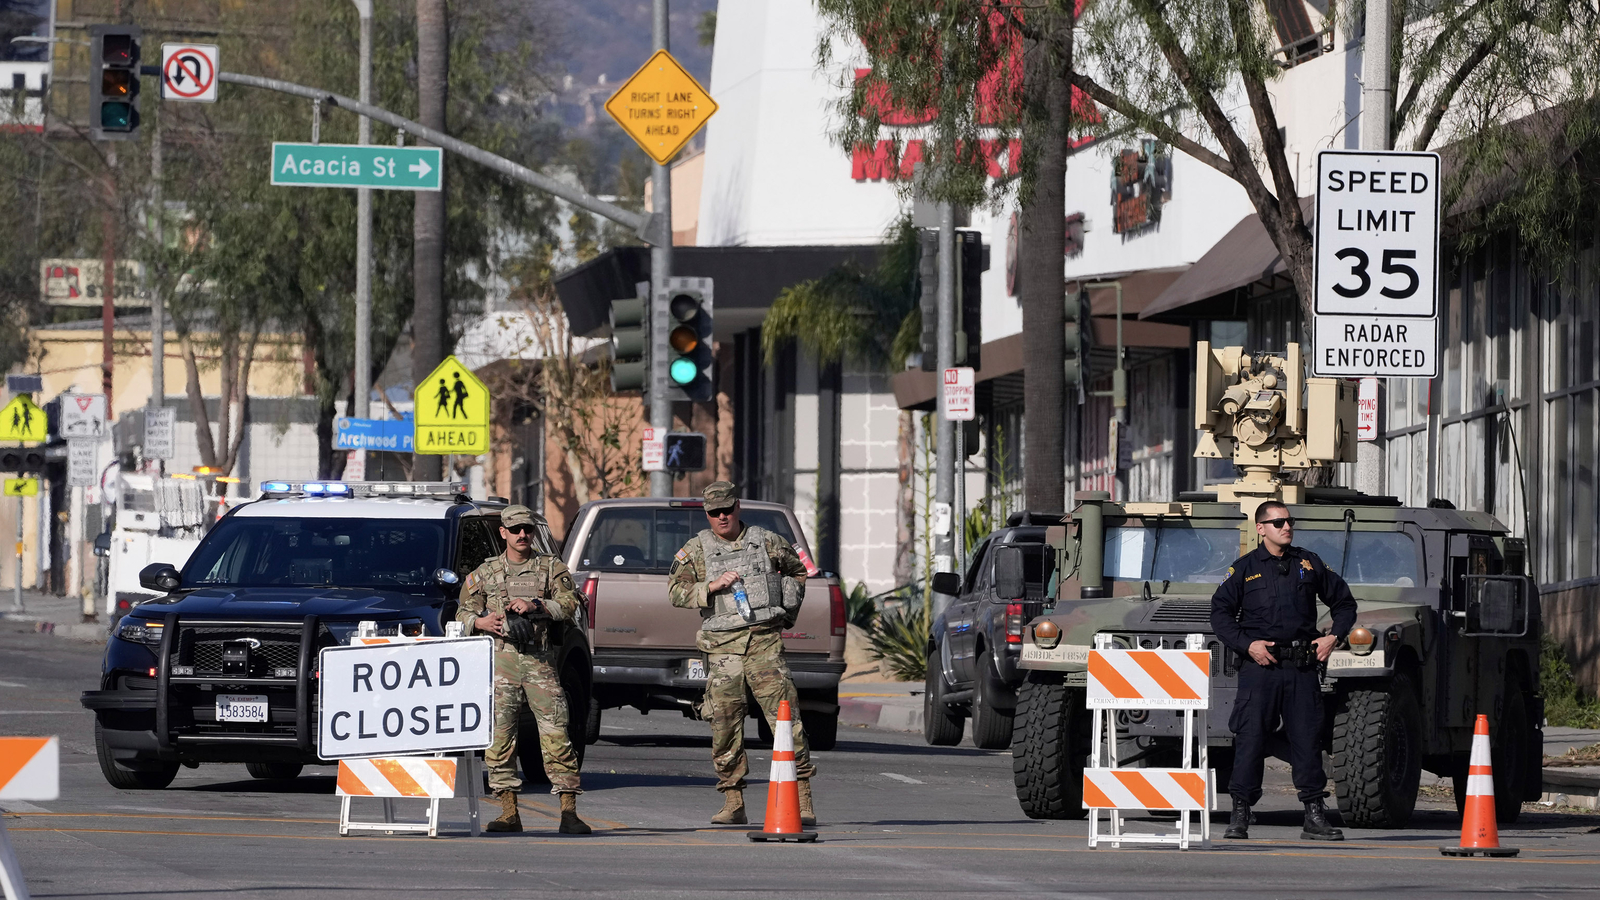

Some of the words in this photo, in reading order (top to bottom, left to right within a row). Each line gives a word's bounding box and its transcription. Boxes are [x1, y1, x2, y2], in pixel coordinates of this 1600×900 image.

[631, 92, 660, 103] RIGHT
[666, 92, 693, 103] LANE
[629, 108, 662, 119] TURNS
[666, 108, 696, 119] RIGHT
[645, 125, 680, 136] AHEAD
[281, 154, 360, 176] Acacia
[372, 156, 396, 178] St
[1327, 170, 1428, 194] SPEED
[1337, 209, 1416, 232] LIMIT
[1331, 247, 1420, 299] 35
[1344, 324, 1407, 343] RADAR
[1325, 348, 1425, 368] ENFORCED
[945, 370, 957, 383] NO
[945, 386, 973, 395] STOPPING
[1358, 399, 1376, 410] PPING
[1361, 412, 1373, 421] TIME
[338, 432, 397, 448] Archwood
[426, 431, 477, 446] AHEAD
[353, 656, 460, 693] ROAD
[219, 704, 264, 718] 1583584
[330, 702, 482, 741] CLOSED
